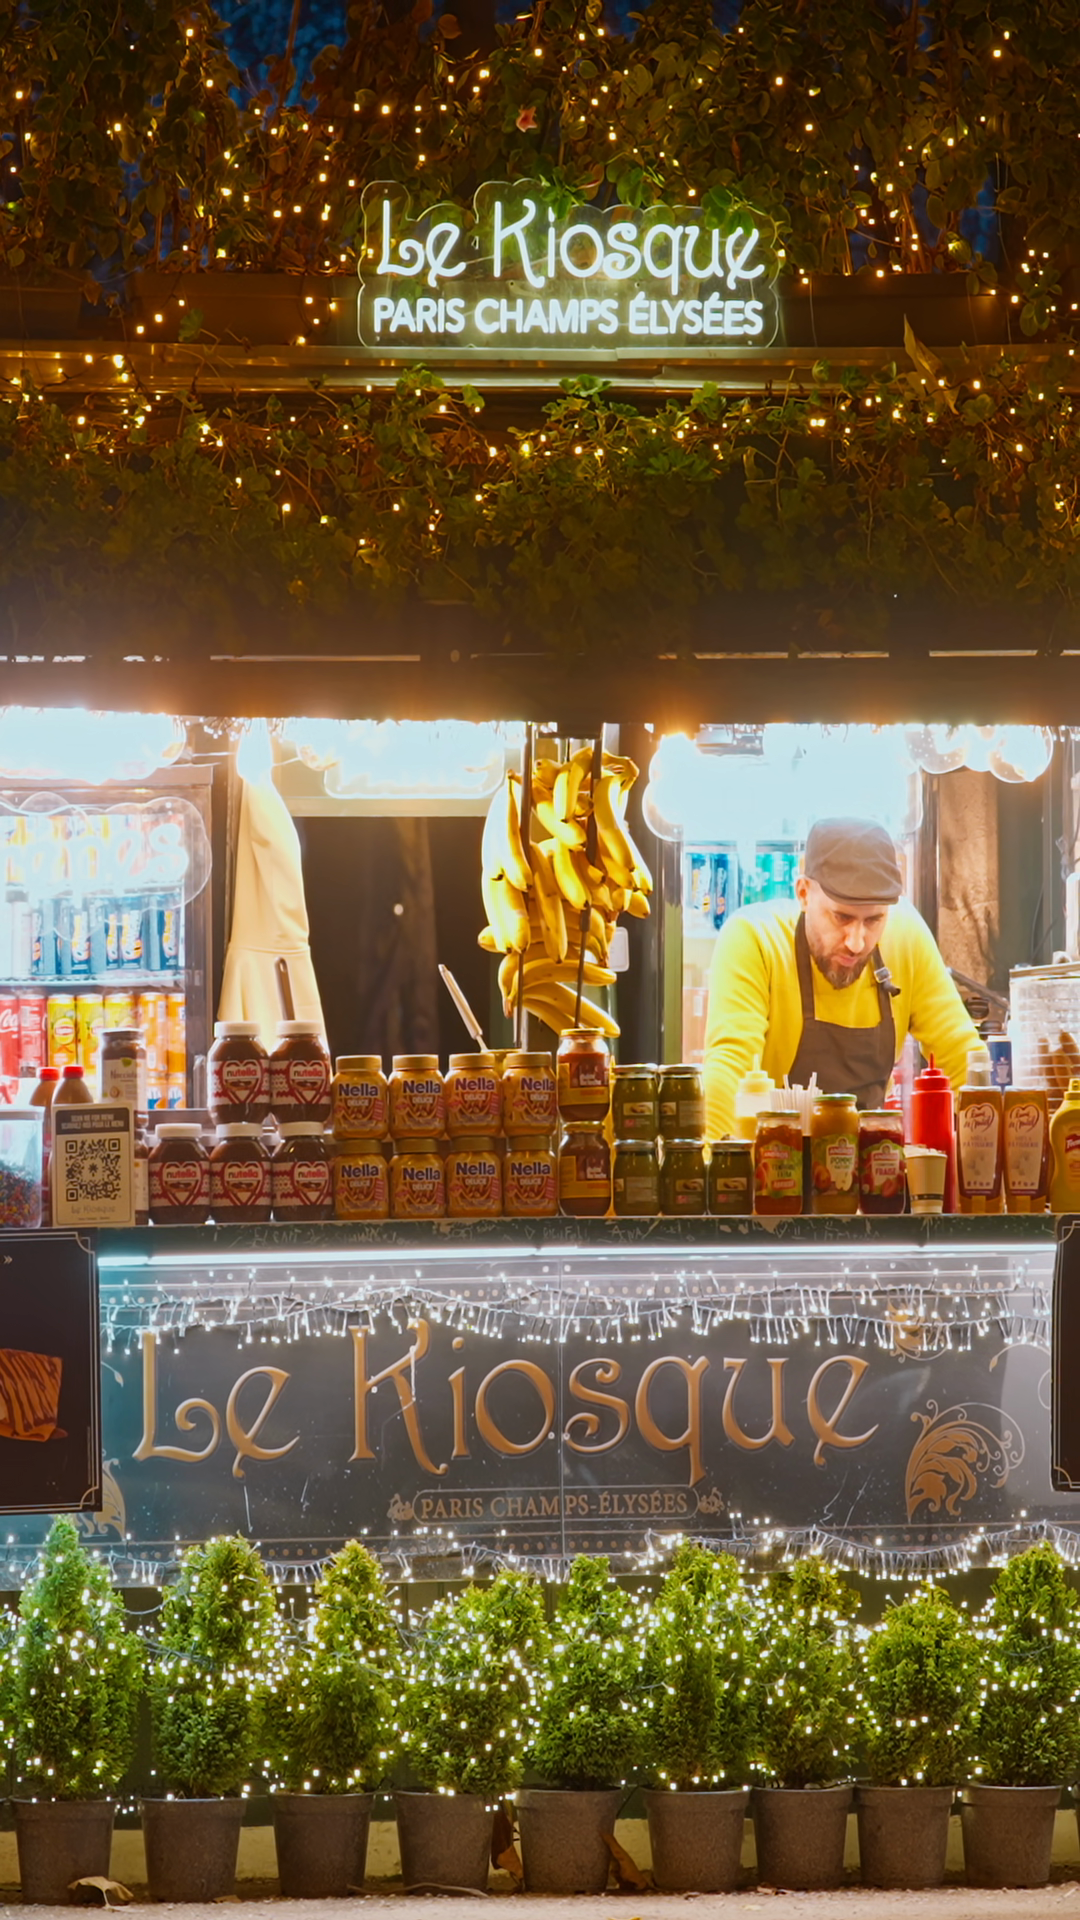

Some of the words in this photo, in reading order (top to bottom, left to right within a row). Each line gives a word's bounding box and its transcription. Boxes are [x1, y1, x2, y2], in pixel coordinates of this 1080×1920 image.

[376, 198, 467, 288] Le
[493, 198, 766, 296] Kiosque
[373, 297, 466, 334] PARIS
[474, 297, 619, 335] CHAMPS
[628, 290, 764, 336] ÉLYSÉES
[226, 1067, 258, 1078] nutella
[293, 1067, 323, 1078] nutella
[338, 1083, 379, 1097] Nella
[402, 1080, 441, 1094] Nella
[455, 1077, 495, 1091] Nella
[521, 1077, 556, 1091] Nella
[165, 1169, 198, 1180] nutella
[227, 1169, 259, 1180] nutella
[297, 1169, 327, 1180] nutella
[341, 1163, 379, 1178] Nella
[402, 1167, 441, 1181] Nella
[456, 1161, 495, 1175] Nella
[511, 1161, 551, 1176] Nella
[131, 1331, 300, 1480] Le
[347, 1317, 880, 1489] Kiosque
[420, 1496, 484, 1520] PARIS
